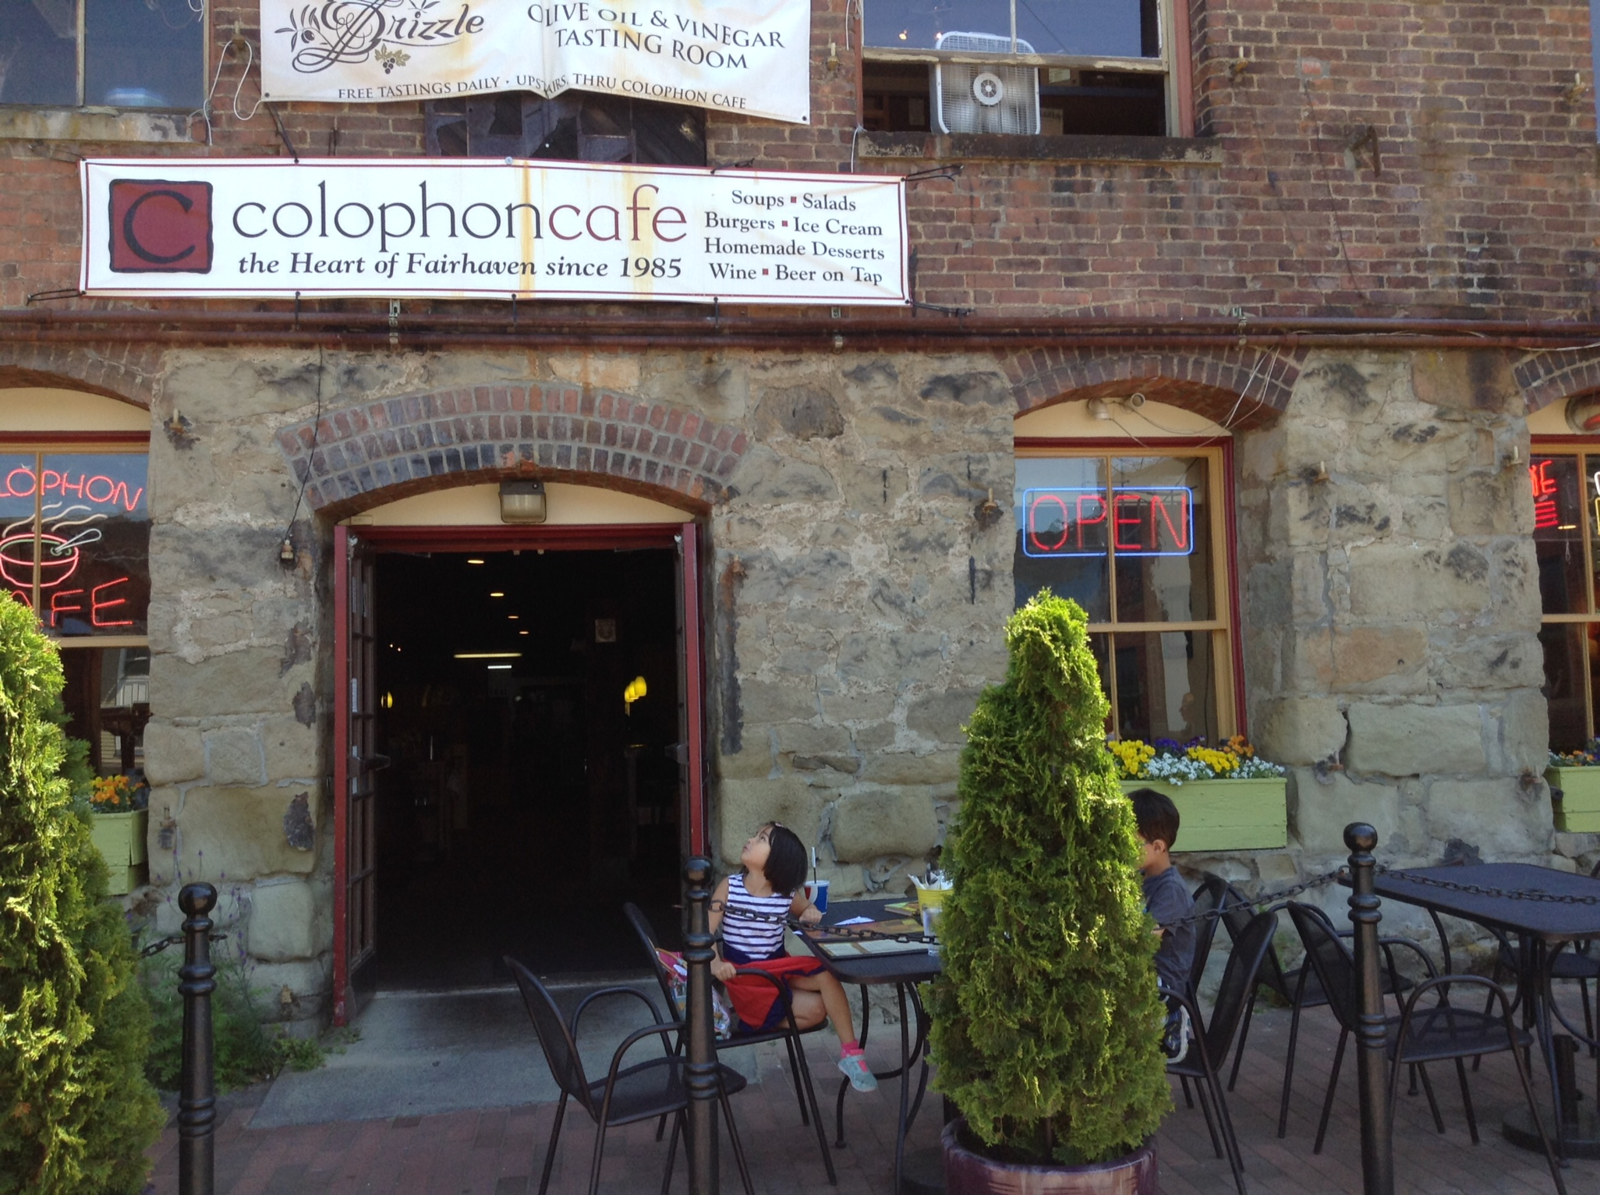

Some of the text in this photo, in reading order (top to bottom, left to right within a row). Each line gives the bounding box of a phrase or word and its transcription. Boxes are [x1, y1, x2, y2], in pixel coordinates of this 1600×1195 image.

[292, 0, 485, 73] Drizzle
[528, 2, 786, 48] OLIVE OIL & VINEGAR
[555, 28, 750, 69] TASTING ROOM
[338, 88, 374, 99] FREE
[377, 82, 452, 98] TASTINGS
[457, 77, 500, 93] DAILY
[572, 73, 617, 89] THRU
[621, 79, 708, 103] COLOPHON
[712, 93, 746, 109] CAFE
[731, 189, 856, 212] Soups Salads
[123, 190, 196, 264] C
[704, 211, 883, 236] Burgers Ice Cream
[239, 252, 682, 279] the Heart of Fairhaven since 1985
[704, 237, 885, 260] Homemade Desserts
[709, 262, 883, 286] Wine Beer on Tap
[0, 468, 143, 511] OPHON
[1029, 494, 1187, 550] OPEN
